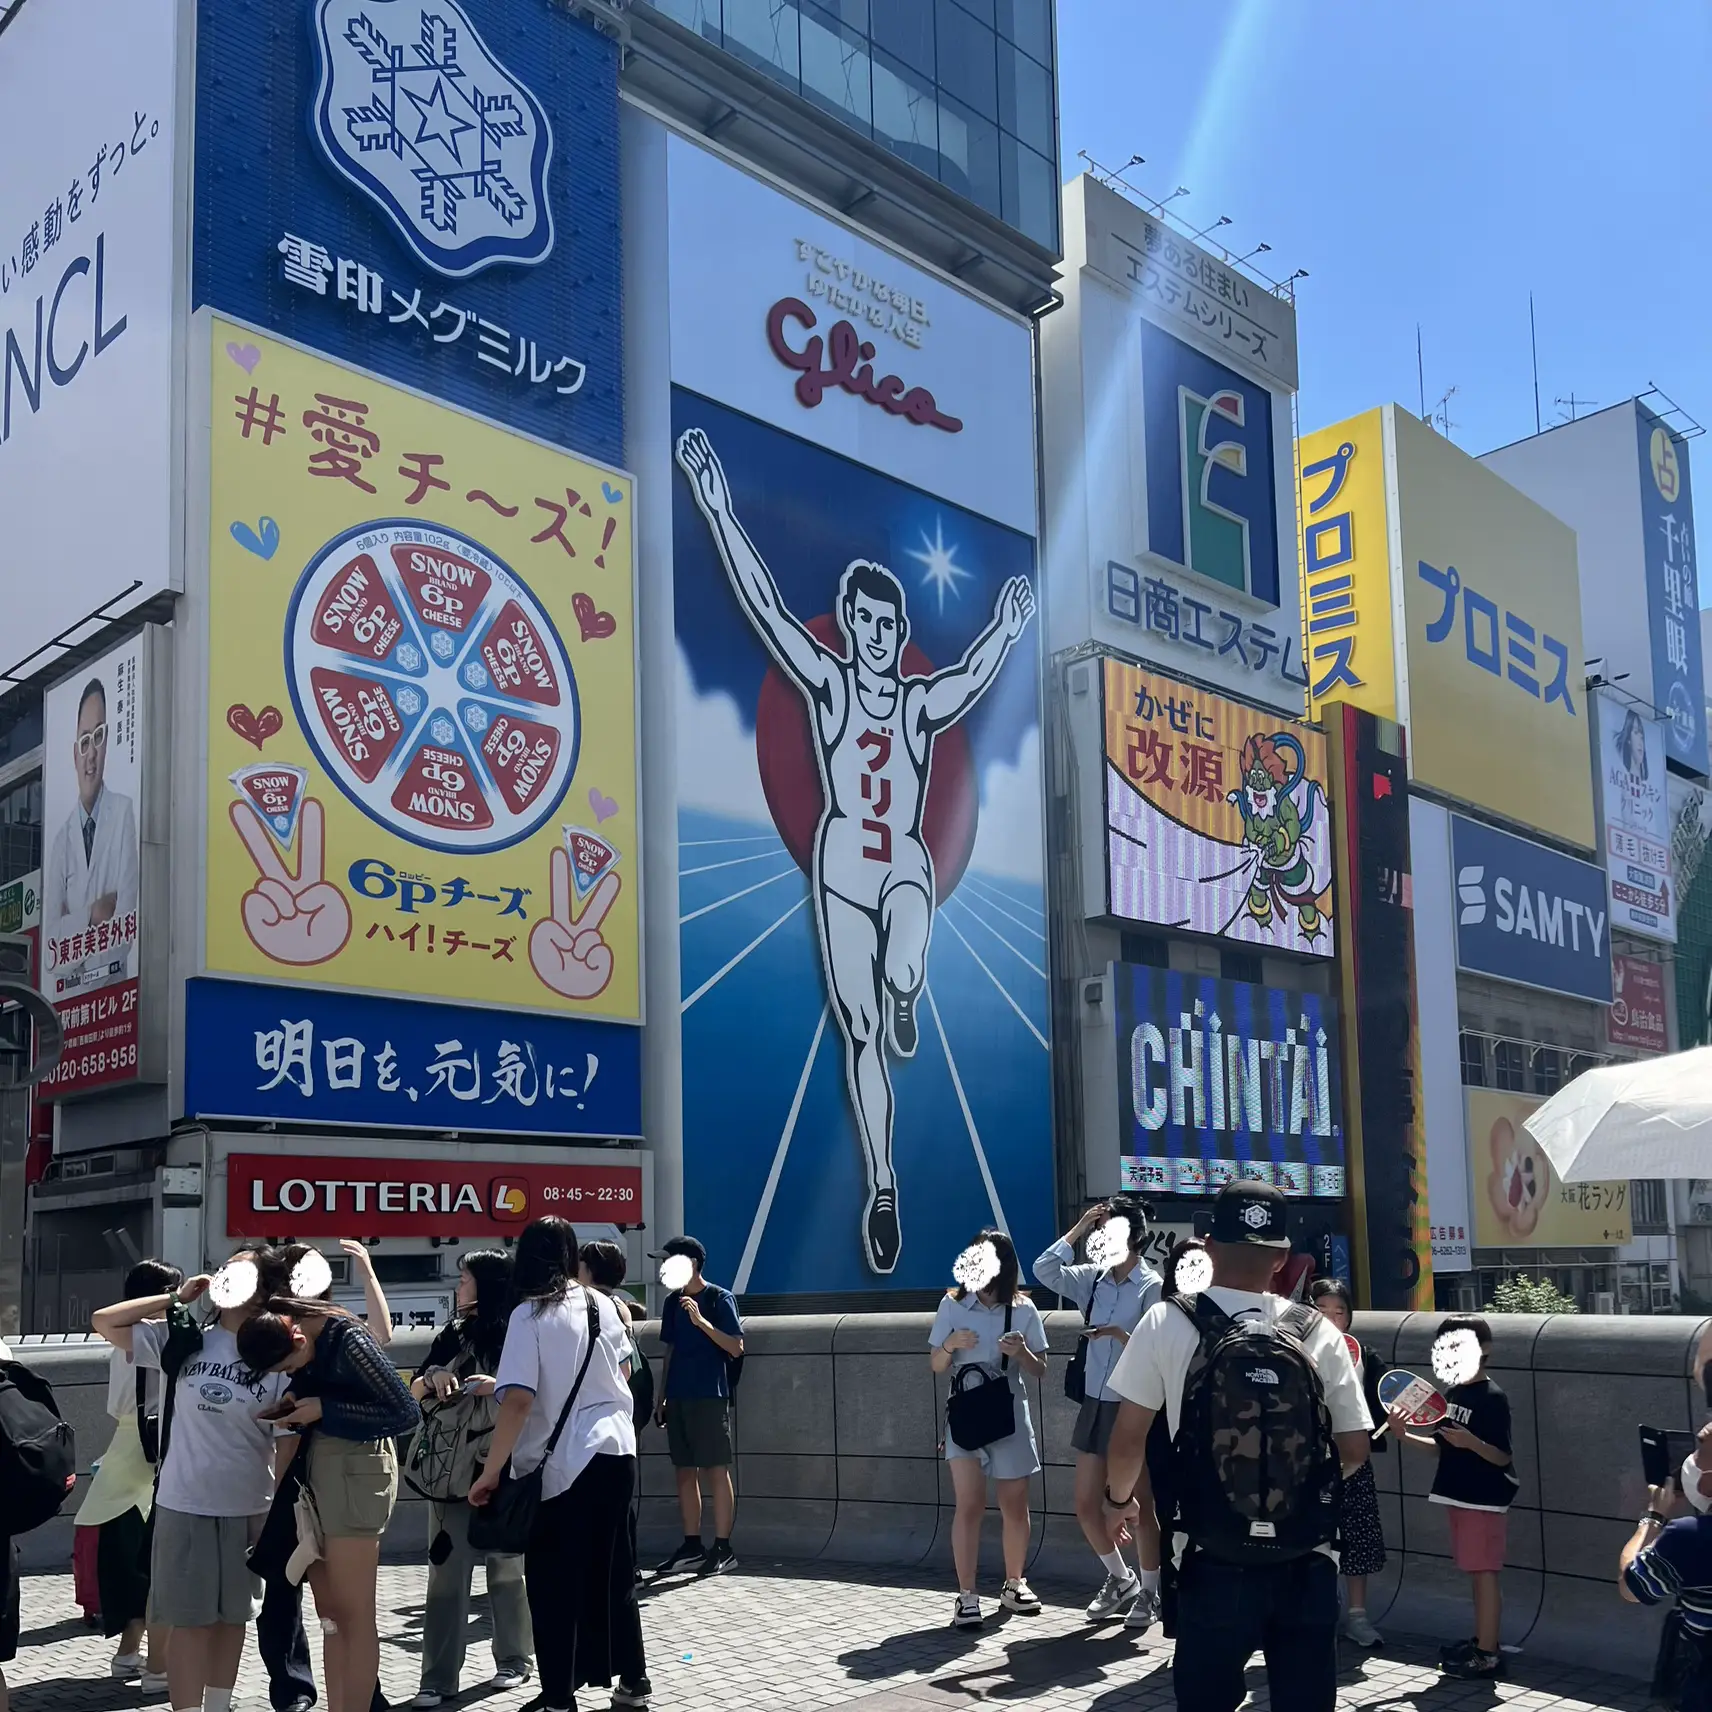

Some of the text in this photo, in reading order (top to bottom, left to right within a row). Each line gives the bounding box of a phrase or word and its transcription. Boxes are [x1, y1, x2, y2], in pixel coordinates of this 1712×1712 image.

[1144, 222, 1248, 307] 夢ある住まい
[278, 232, 586, 396] 雪印メグミルク
[1127, 255, 1267, 362] エステムシリーズ
[0, 231, 127, 445] NCL
[766, 297, 963, 433] Glico
[410, 552, 476, 587] SNOW
[429, 577, 457, 591] BRAND
[1302, 441, 1366, 699] プロミス
[1659, 513, 1688, 675] 千里眼
[322, 565, 369, 633] SNOW
[348, 597, 368, 625] BRAND
[422, 609, 462, 628] CHEESE
[1107, 559, 1308, 687] 日商エステム
[373, 618, 400, 656] CHEESE
[511, 620, 553, 689] SNOW
[514, 643, 530, 675] BRAND
[1418, 560, 1576, 716] プロミス
[484, 645, 508, 689] CHEESE
[319, 687, 370, 761] SNOW
[348, 702, 367, 736] BRAND
[373, 686, 400, 731] CHEESE
[1134, 684, 1215, 741] かぜに
[423, 749, 463, 766] CHEESE
[484, 718, 508, 754] CHEESE
[514, 746, 530, 773] BRAND
[252, 776, 289, 789] SNOW
[513, 738, 551, 802] SNOW
[1125, 724, 1224, 803] 改源
[408, 792, 475, 822] SNOW
[428, 787, 457, 799] BRAND
[855, 726, 894, 864] グリコ
[577, 837, 606, 857] SNOW
[59, 910, 137, 964] 東京美容外科
[1495, 877, 1604, 958] SAMTY
[122, 989, 137, 1012] 2F
[252, 1178, 483, 1213] LOTTERIA
